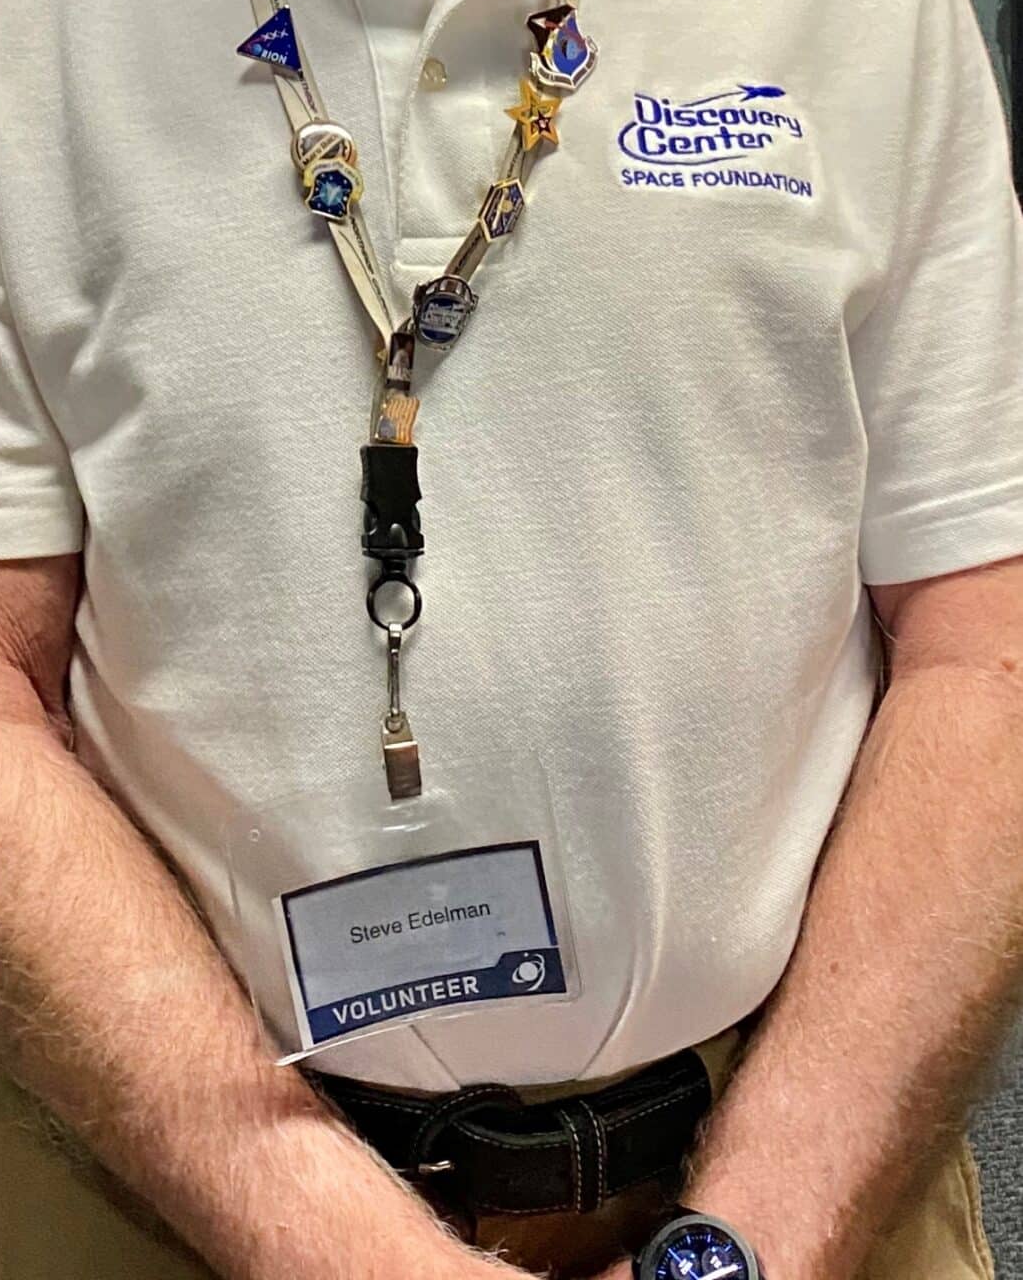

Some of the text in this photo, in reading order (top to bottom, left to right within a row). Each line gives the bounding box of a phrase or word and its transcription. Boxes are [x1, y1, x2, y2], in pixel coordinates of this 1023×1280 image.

[635, 93, 803, 138] Discovery
[637, 126, 774, 156] Center
[621, 170, 813, 198] SPACE FOUNDATION
[349, 902, 492, 944] Steve Edelman
[332, 975, 480, 1025] VOLUNTEER
